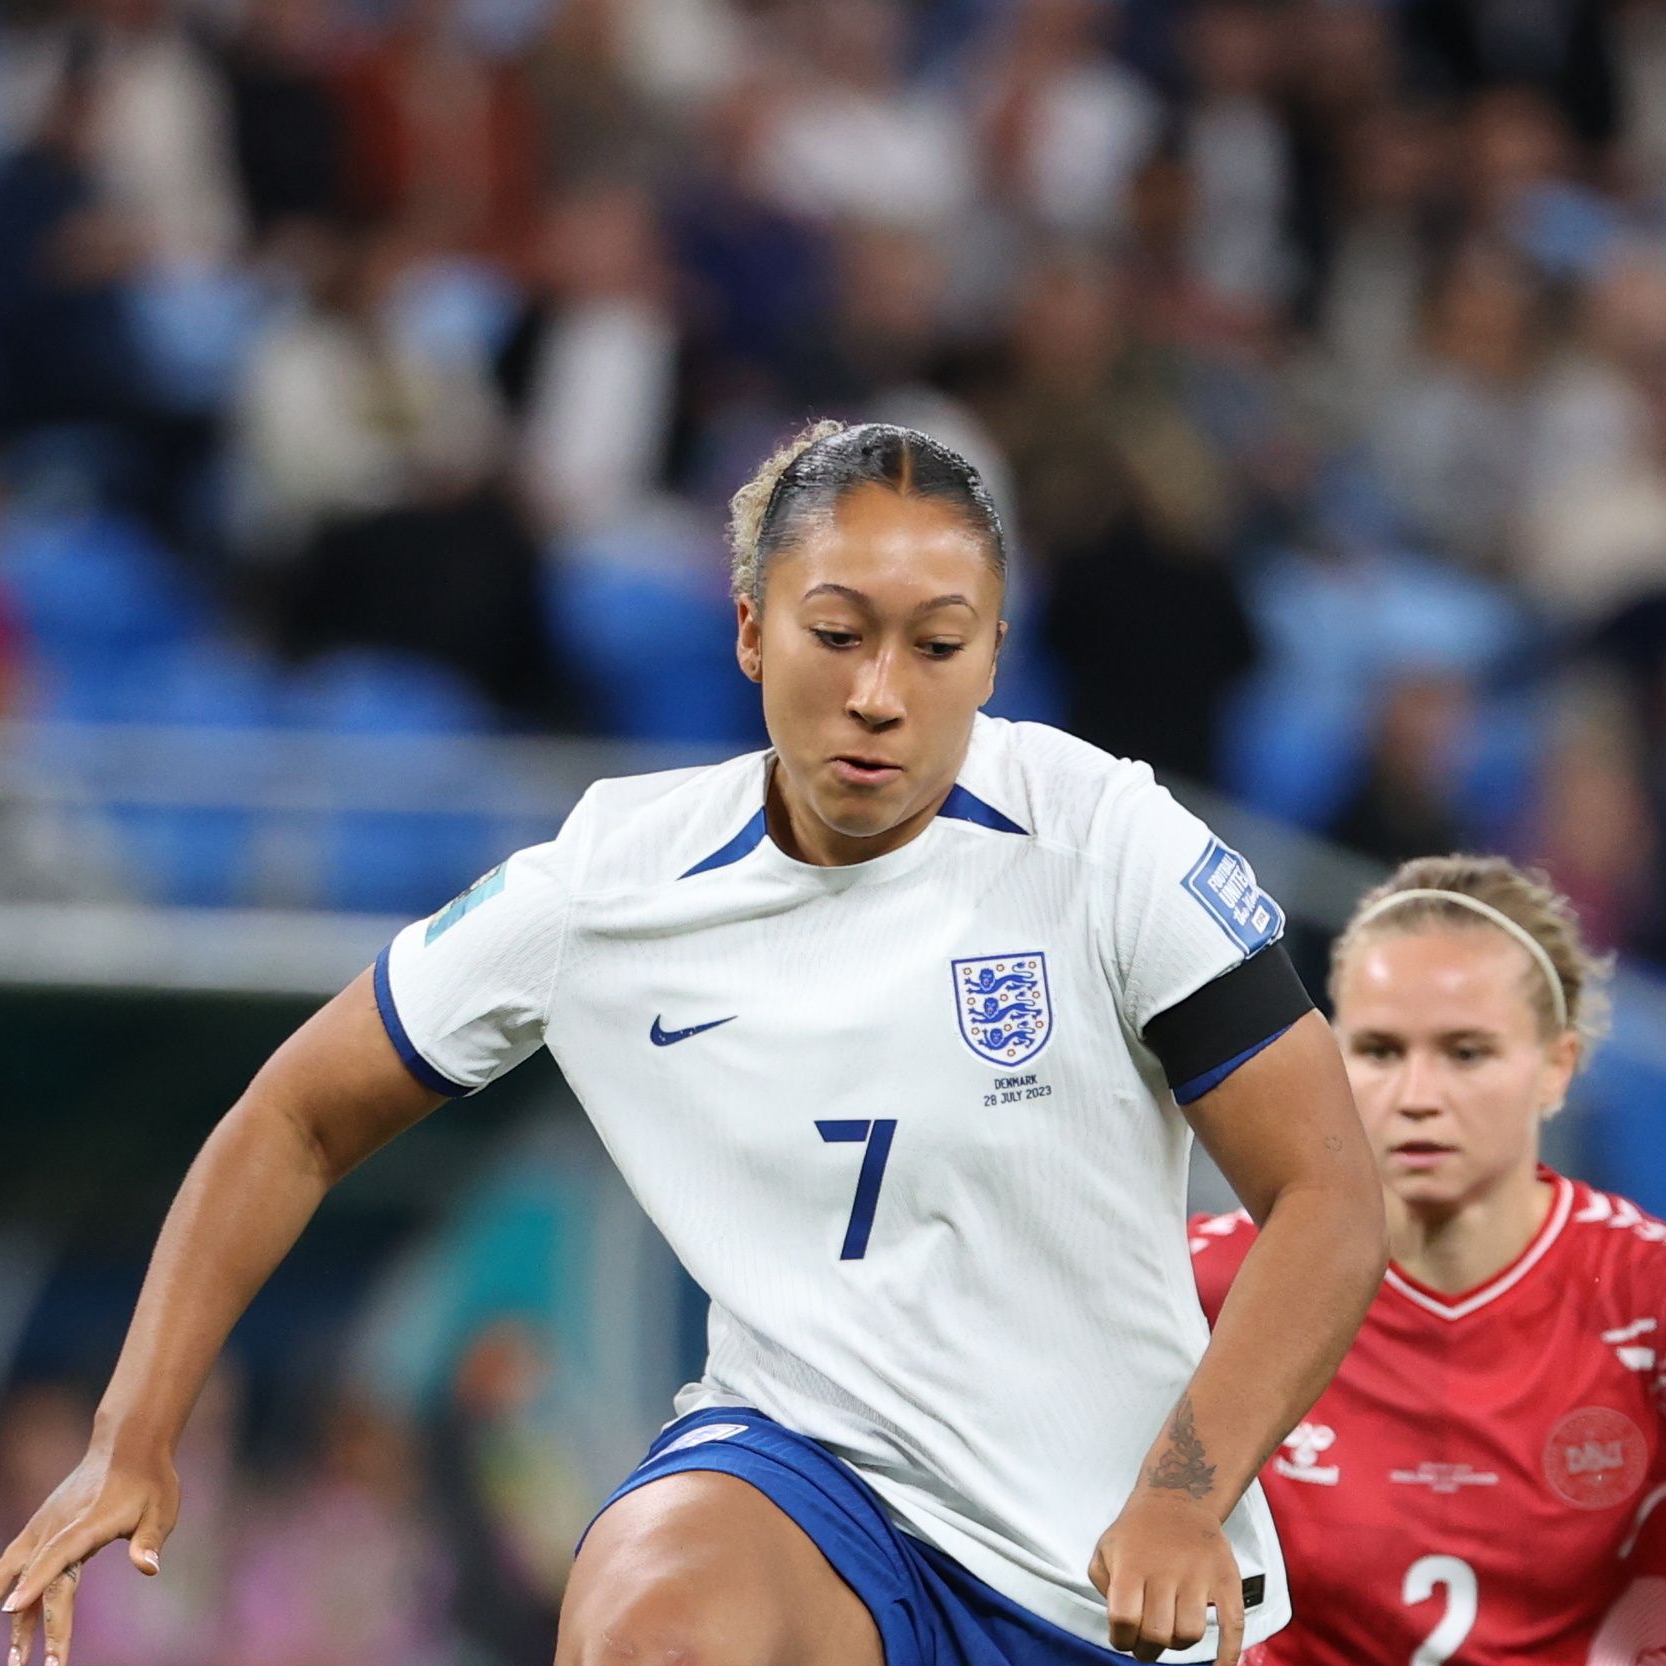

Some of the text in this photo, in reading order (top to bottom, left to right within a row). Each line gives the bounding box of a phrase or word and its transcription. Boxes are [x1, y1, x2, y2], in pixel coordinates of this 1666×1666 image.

[1219, 865, 1249, 909] UNITE
[983, 1085, 1052, 1107] 28 JULY 2023
[994, 1074, 1038, 1090] DENMARK
[814, 1119, 898, 1261] 7
